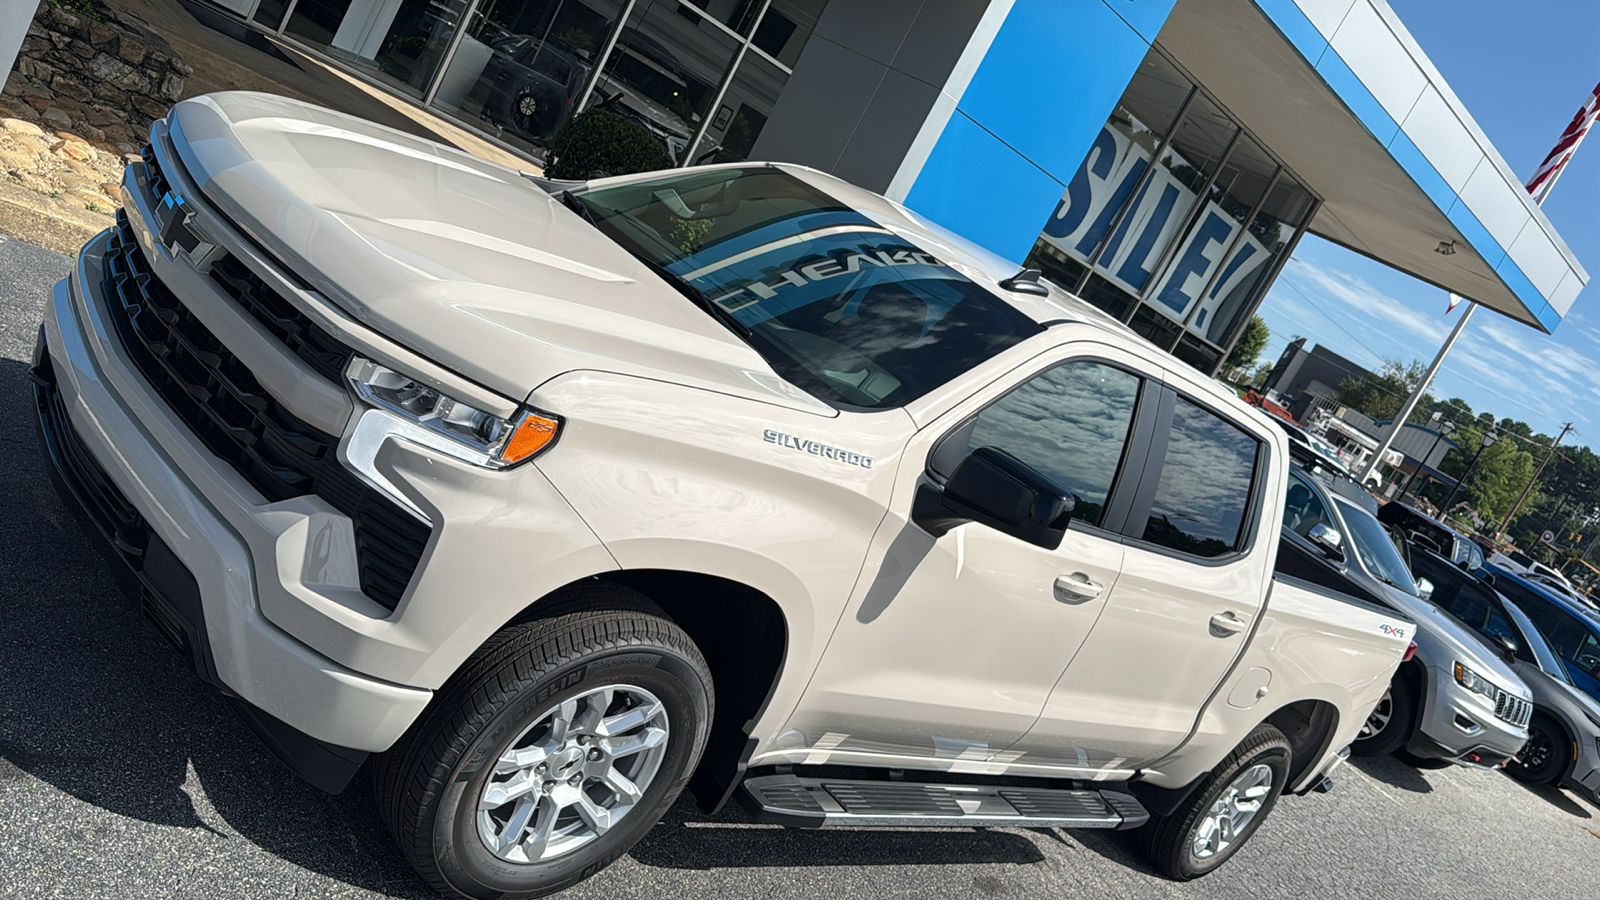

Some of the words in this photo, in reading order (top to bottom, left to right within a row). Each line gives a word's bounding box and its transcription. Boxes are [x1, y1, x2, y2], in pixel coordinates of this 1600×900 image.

[1043, 127, 1257, 329] SALE!
[763, 429, 875, 469] SILVERADO
[490, 669, 583, 743] MICHELIN
